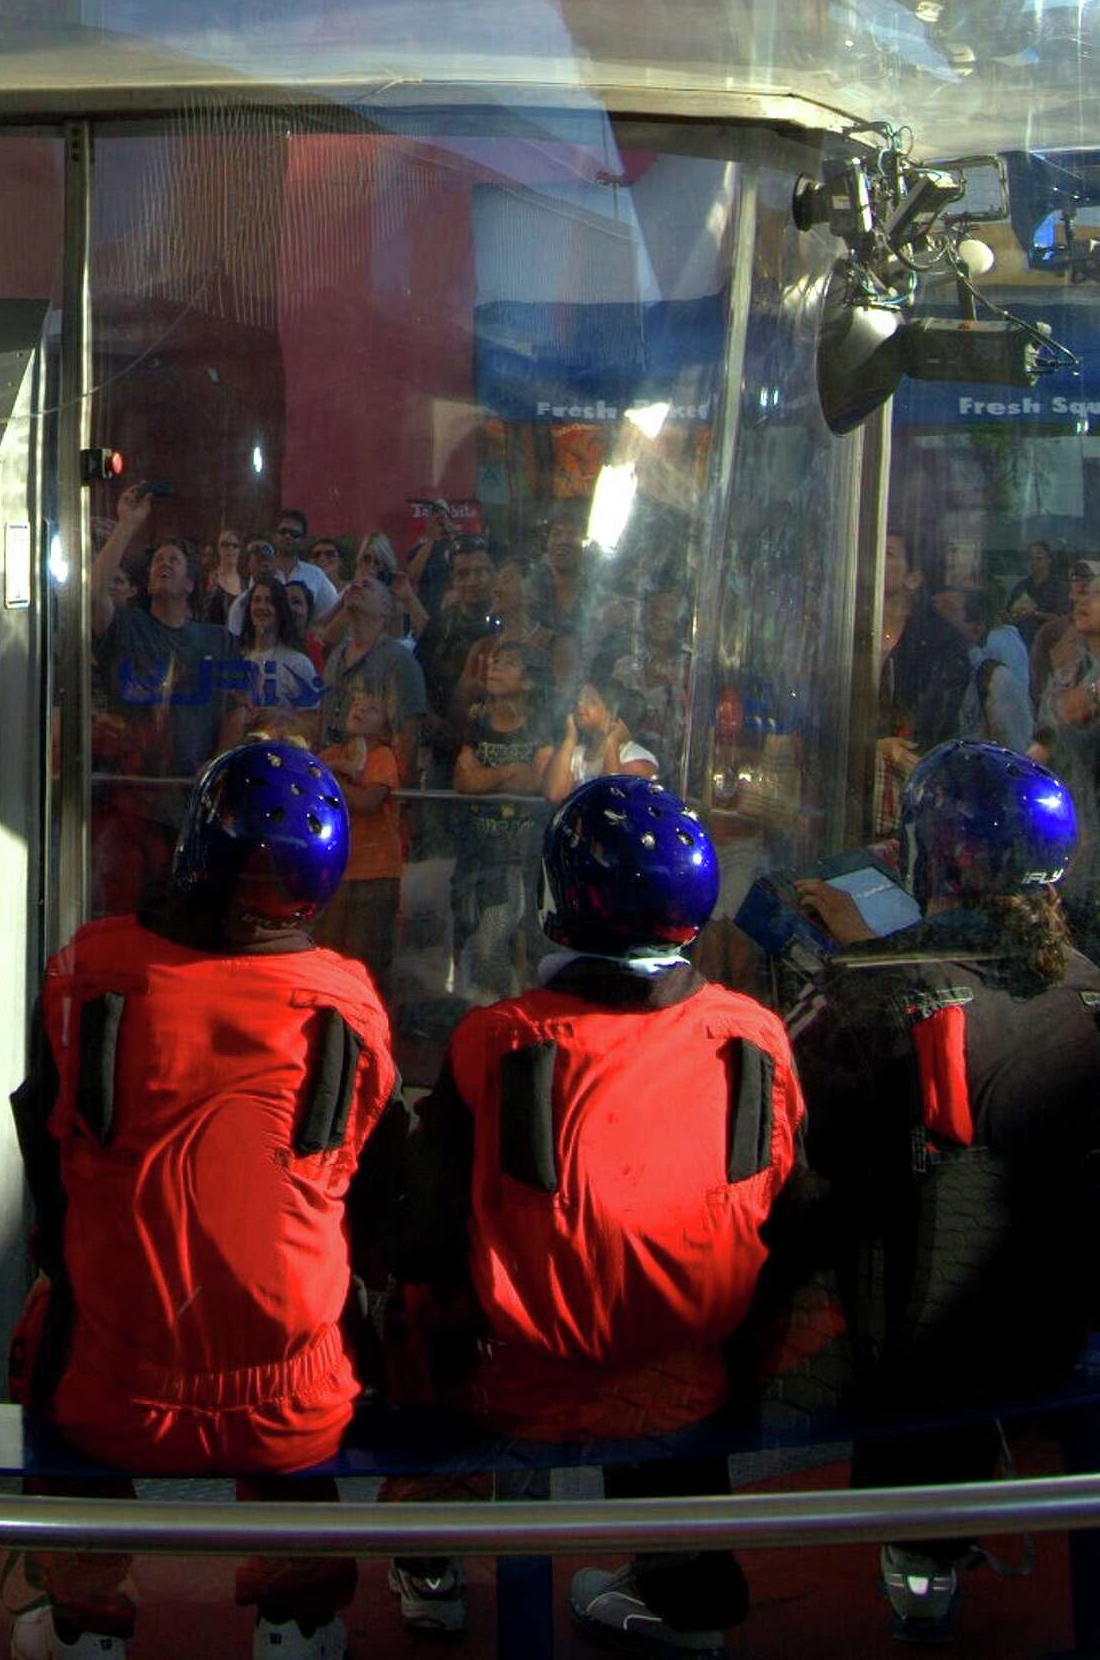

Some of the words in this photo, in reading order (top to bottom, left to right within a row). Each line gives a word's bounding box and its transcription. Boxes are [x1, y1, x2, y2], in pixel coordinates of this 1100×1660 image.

[536, 400, 617, 420] Fresh
[959, 397, 1040, 415] Fresh
[1021, 868, 1064, 884] iFLY
